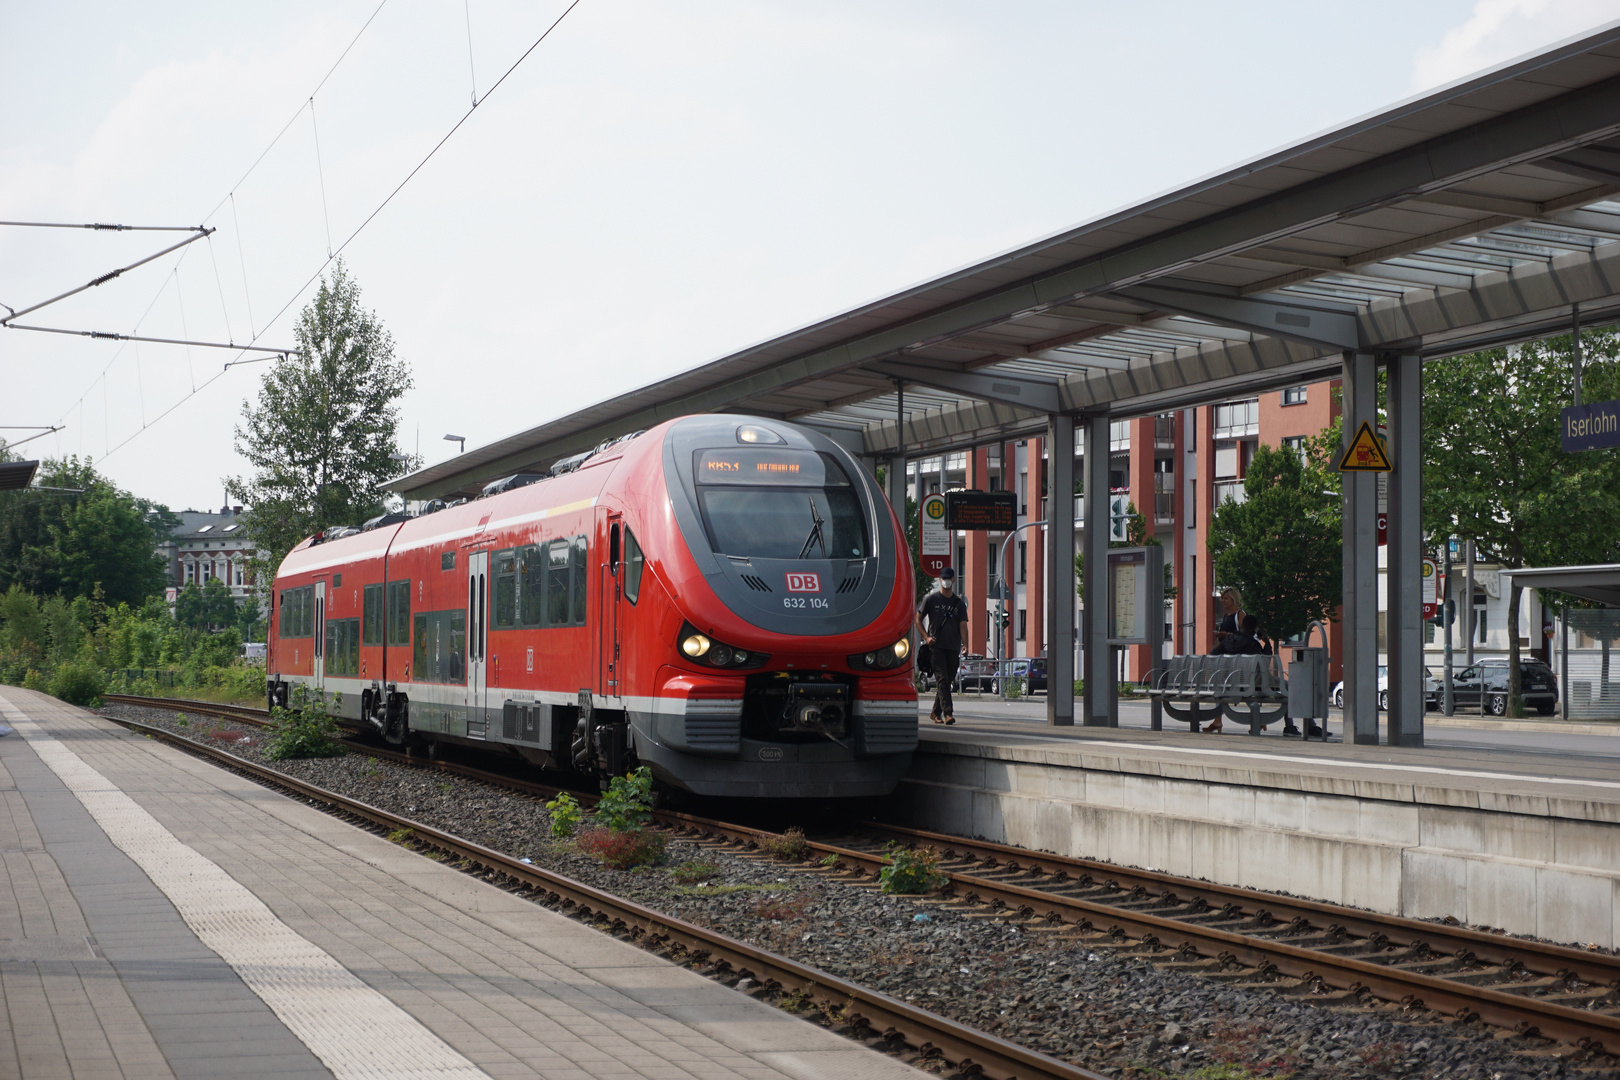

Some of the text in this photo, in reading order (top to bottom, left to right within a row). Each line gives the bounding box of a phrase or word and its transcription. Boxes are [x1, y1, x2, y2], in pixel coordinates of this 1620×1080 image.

[1567, 410, 1617, 438] Iserlohn
[1377, 518, 1387, 530] C
[931, 560, 943, 569] 1D
[787, 574, 819, 591] DB
[783, 597, 829, 609] 632 104
